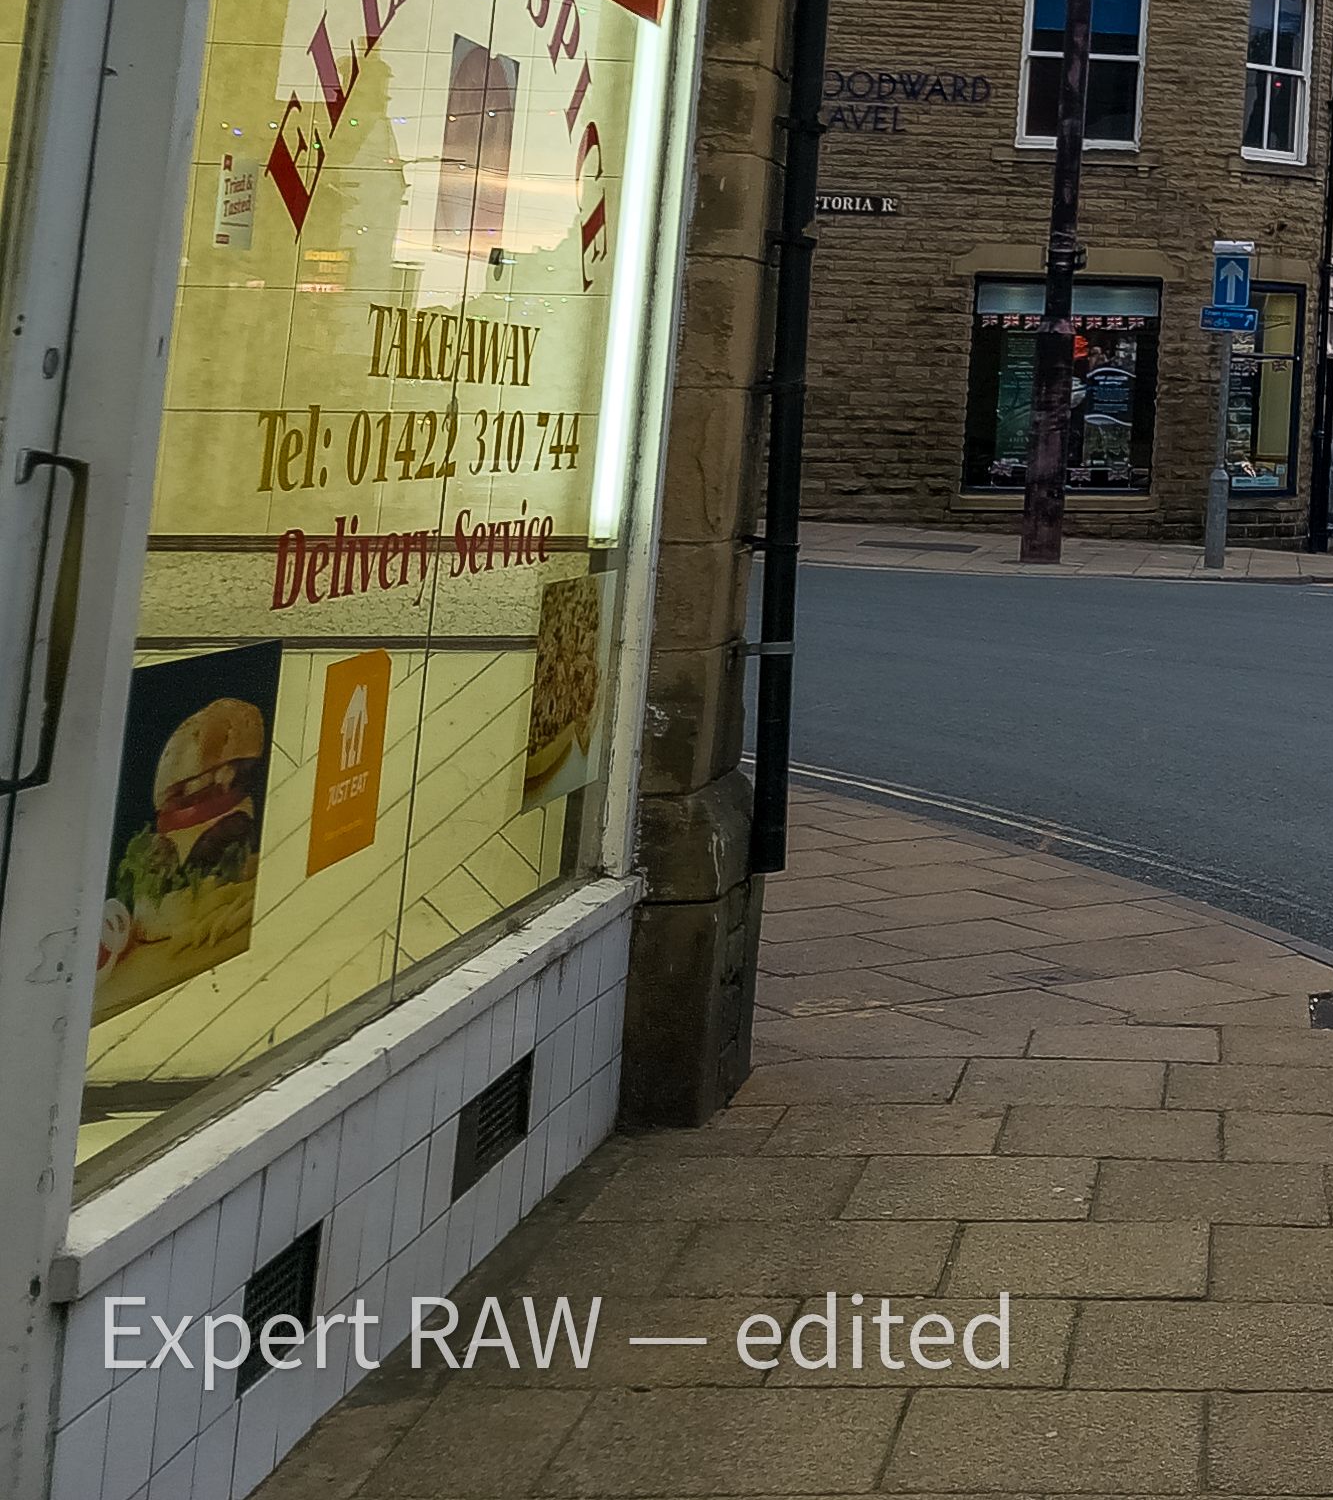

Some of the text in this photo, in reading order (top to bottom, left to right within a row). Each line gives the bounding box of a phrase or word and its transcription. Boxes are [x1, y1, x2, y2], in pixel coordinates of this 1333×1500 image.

[824, 69, 992, 102] OODWARD
[828, 105, 905, 132] AVEL
[815, 196, 873, 212] TORIA
[369, 304, 540, 387] TAKEAWAY
[257, 405, 581, 492] Tel: 01422 310 744
[270, 499, 553, 611] Delivery Service
[326, 771, 369, 812] JUST EAT
